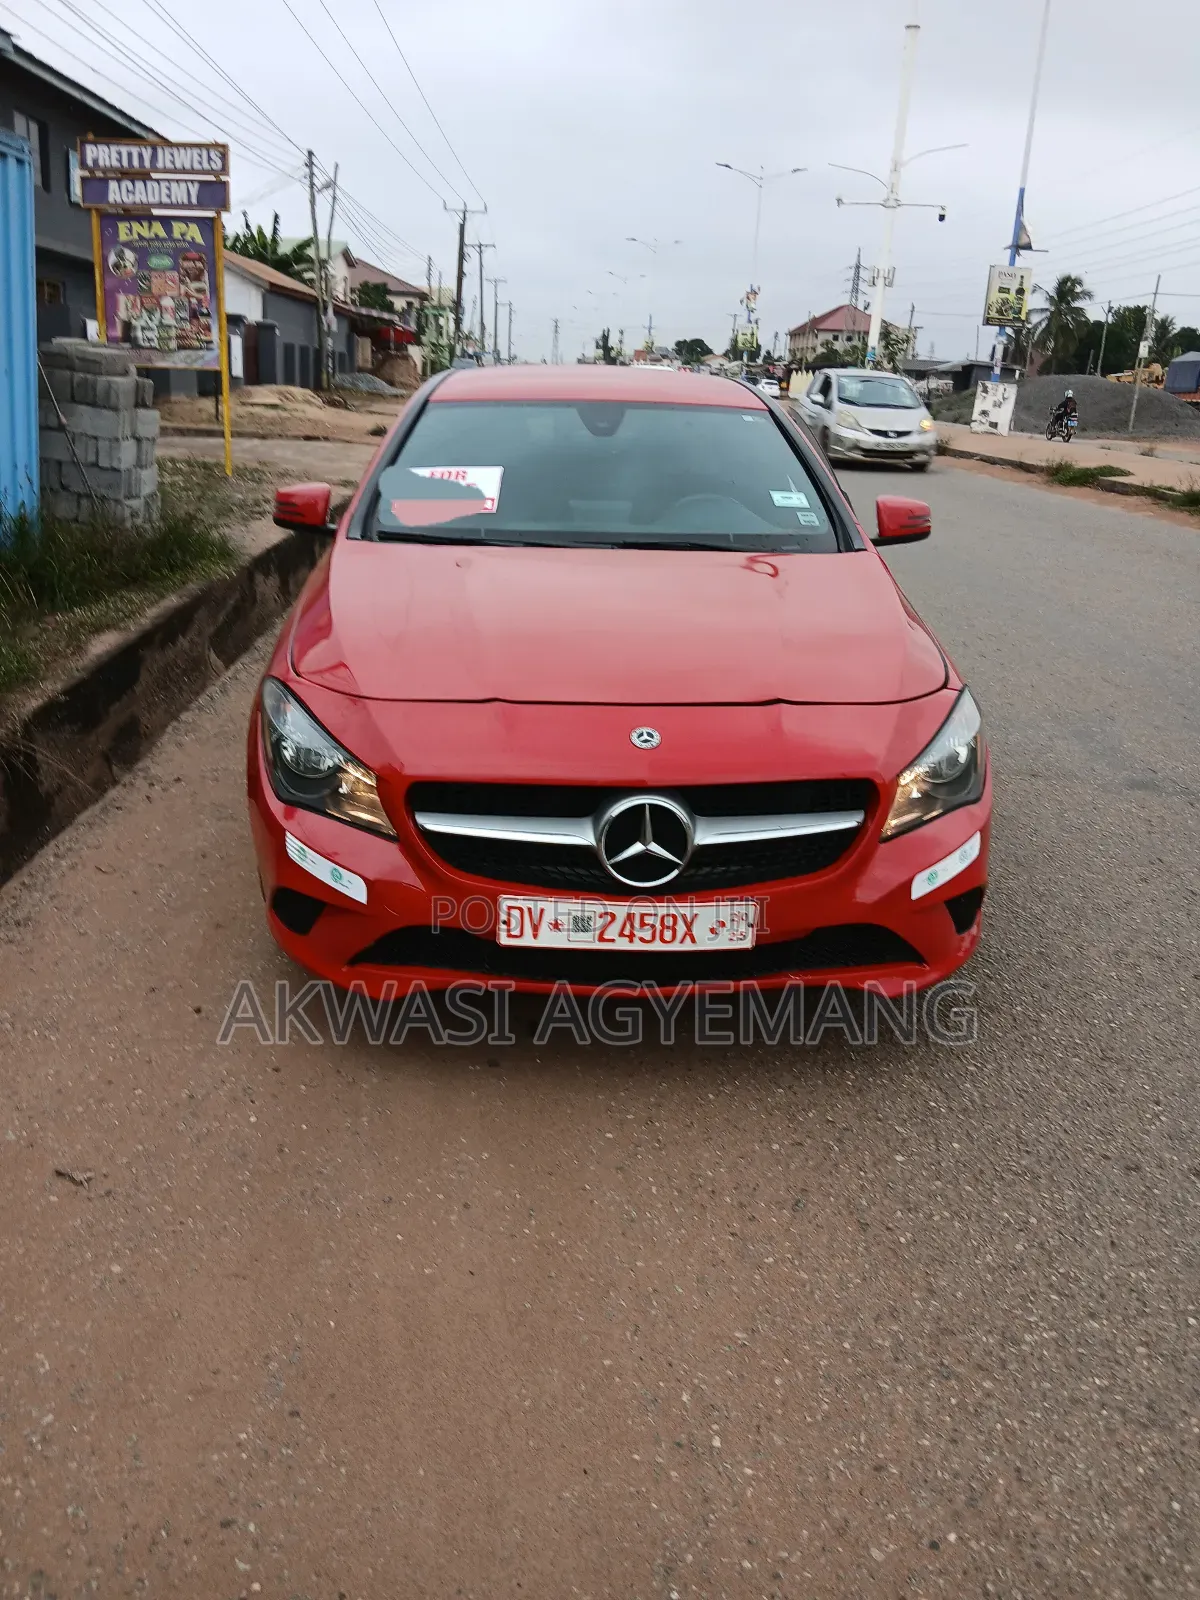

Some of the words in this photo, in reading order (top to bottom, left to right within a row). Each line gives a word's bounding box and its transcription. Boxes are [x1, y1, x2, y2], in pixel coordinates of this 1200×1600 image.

[85, 143, 153, 169] PRETTY
[155, 145, 224, 171] JEWELS
[108, 179, 200, 205] ACADEMY
[116, 220, 169, 243] ENA
[171, 220, 206, 246] PA
[505, 905, 546, 941] DV
[596, 910, 700, 945] 2458X
